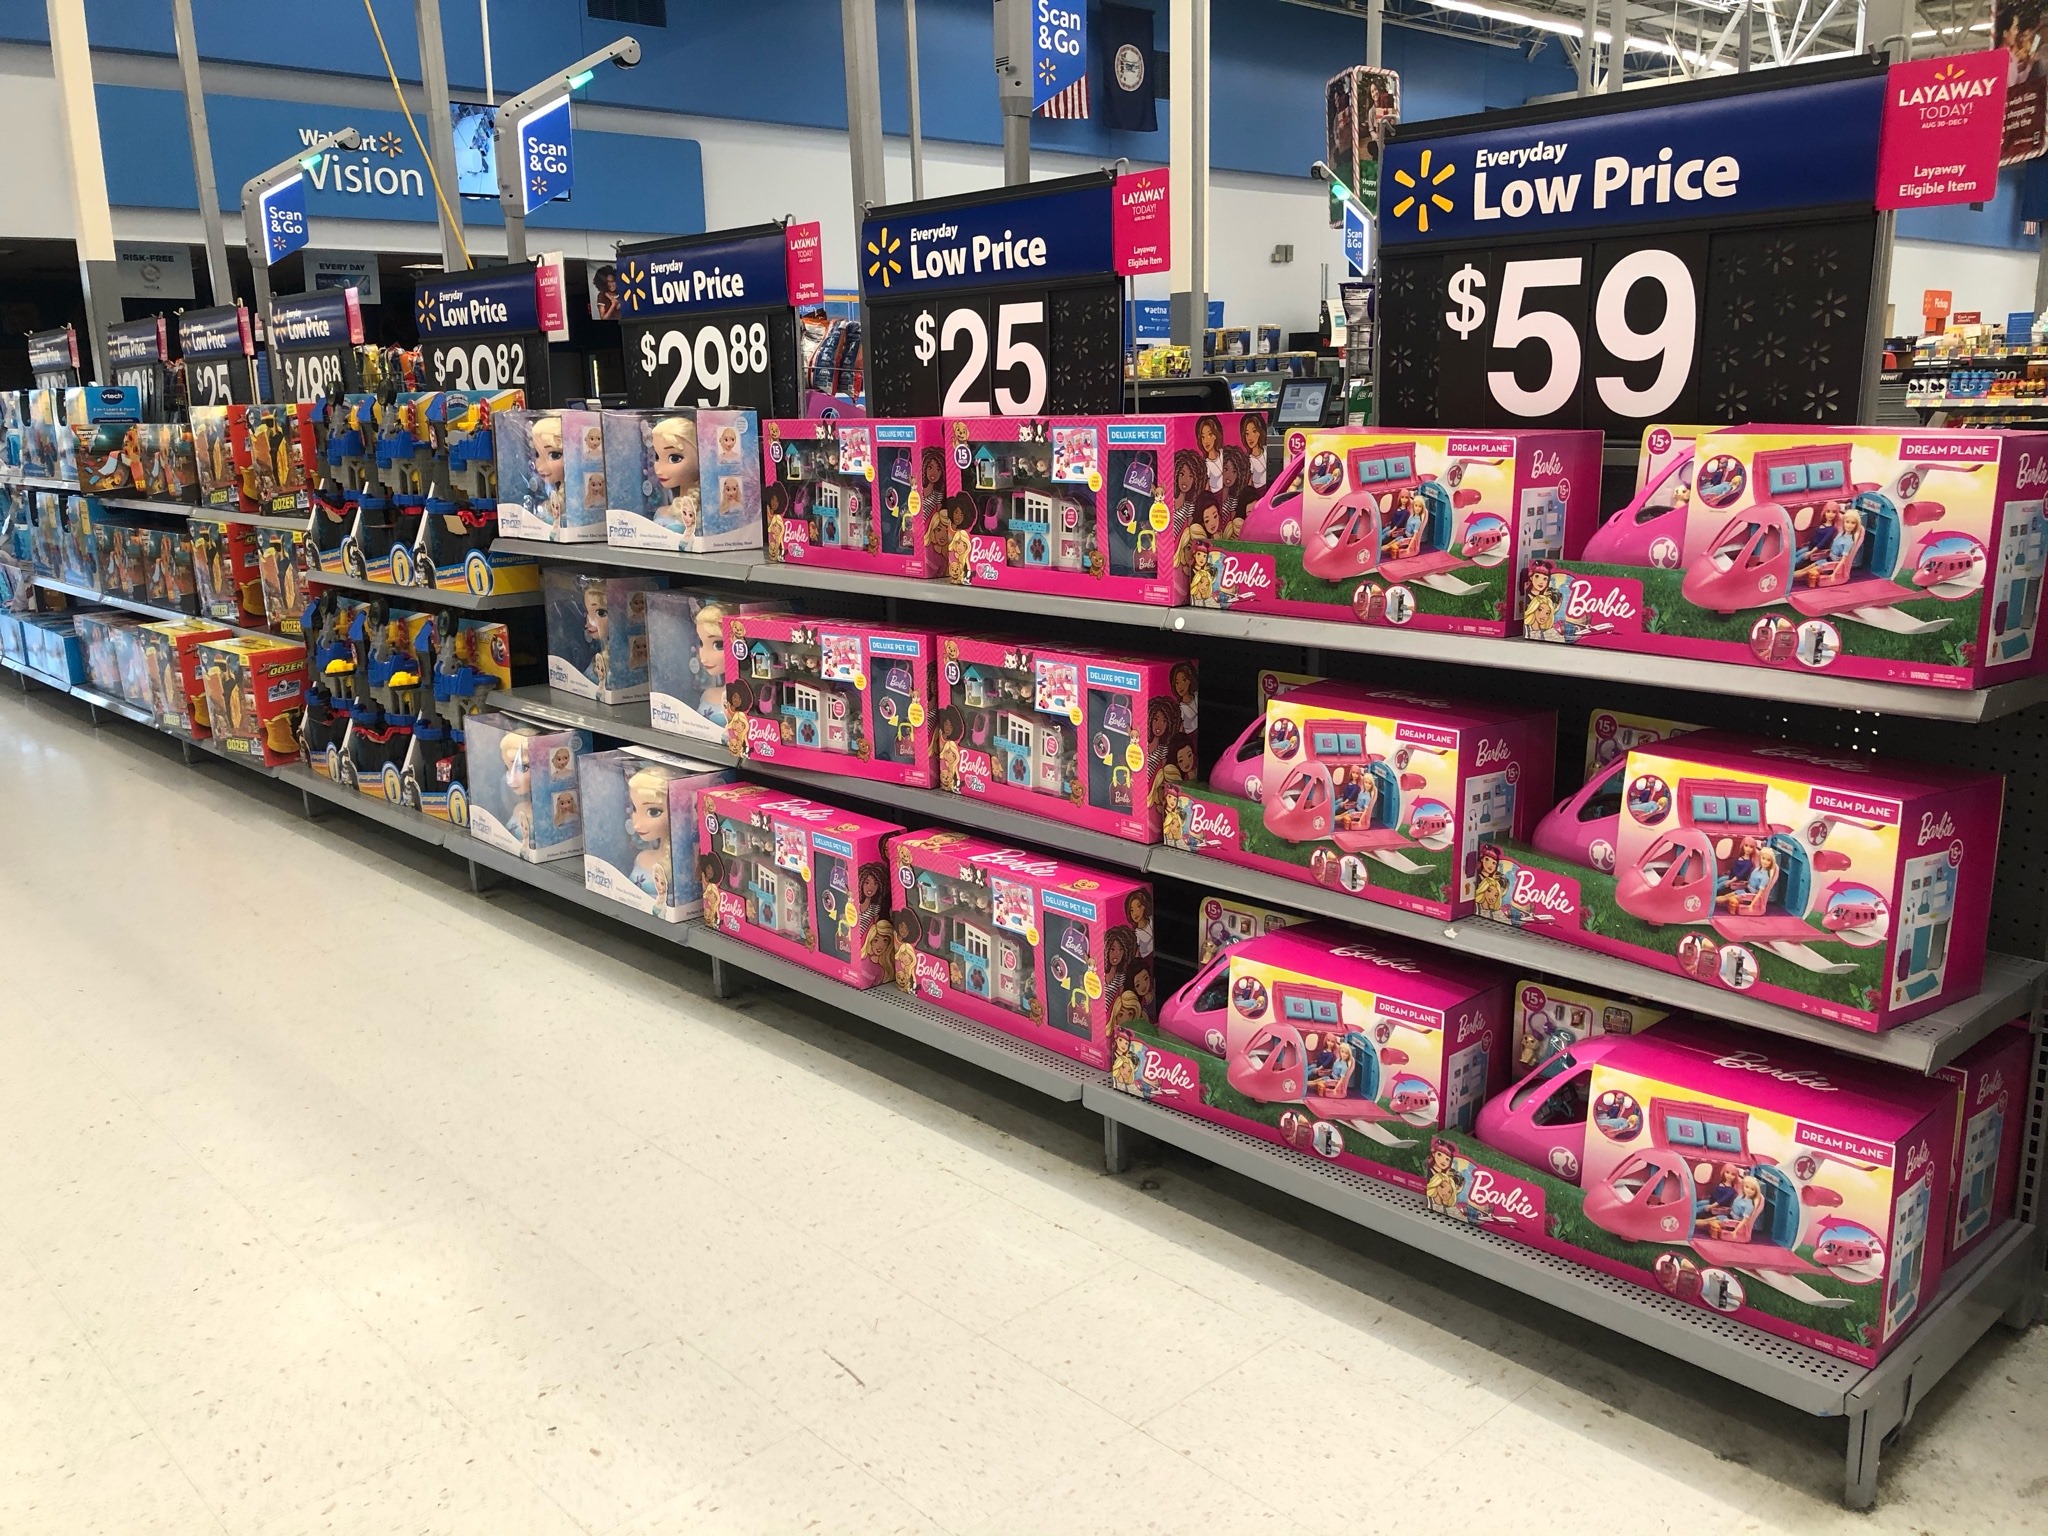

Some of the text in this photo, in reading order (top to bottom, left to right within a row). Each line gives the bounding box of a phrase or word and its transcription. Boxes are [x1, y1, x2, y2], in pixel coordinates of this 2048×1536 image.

[1037, 0, 1081, 31] Scan
[1038, 25, 1080, 56] &Go
[1898, 77, 1997, 107] LAYAWAY
[1919, 102, 1973, 120] TODAY!
[299, 128, 377, 151] Walrt
[527, 137, 567, 157] Scan
[529, 153, 567, 175] &Go
[1476, 142, 1567, 170] Everyday
[307, 153, 424, 196] Vision
[1914, 164, 1966, 179] Layaway
[1473, 148, 1738, 221] Low Price
[1899, 180, 1976, 198] Eligible Item
[1122, 187, 1166, 206] LAYAWAY
[269, 206, 302, 221] Scan
[1132, 204, 1157, 216] TODAY!
[271, 219, 303, 234] &Go
[910, 223, 958, 245] Everyday
[1347, 229, 1362, 240] Scan
[790, 237, 818, 250] LAYAWAY
[1133, 246, 1157, 255] Layaway
[1347, 238, 1362, 249] &Go
[122, 253, 175, 263] RISK-FREE
[910, 229, 1047, 281] Low Price
[1128, 256, 1162, 269] Eligible Item
[319, 263, 365, 272] EVERY DAY
[651, 260, 683, 274] Everyday
[651, 267, 744, 305] Low Price
[439, 290, 463, 302] Everyday
[440, 298, 507, 327] Low Price
[287, 315, 330, 340] Low Price
[1445, 250, 1696, 418] $59
[191, 330, 227, 351] Low Price
[914, 302, 1047, 417] $25
[1111, 430, 1163, 440] DELUXE PET SET
[1290, 436, 1305, 451] 15+
[1652, 435, 1670, 448] 15+
[773, 446, 780, 455] 15
[957, 448, 967, 459] 15
[1451, 443, 1508, 453] DREAM PLANE
[1906, 445, 1990, 456] DREAM PLANE
[894, 465, 908, 480] Barbie
[1531, 450, 1563, 479] Barbie
[1129, 470, 1147, 489] Barbie
[609, 526, 637, 538] FROZEN
[784, 521, 809, 543] Barbie
[970, 536, 1005, 564] Barbie
[1221, 555, 1271, 590] Barbie
[1568, 580, 1636, 619] Barbie
[735, 643, 744, 653] 15
[872, 642, 916, 653] DELUXE PET SET
[948, 665, 957, 676] 15
[1090, 672, 1137, 686] DELUXE PET SET
[891, 675, 907, 690] Barbie
[1263, 677, 1279, 693] 15+
[652, 709, 680, 725] FROZEN
[1108, 713, 1128, 729] Barbie
[1598, 718, 1615, 733] 15+
[748, 719, 779, 743] Barbie
[1399, 728, 1453, 745] DREAM PLANE
[1475, 738, 1511, 767] Barbie
[959, 750, 990, 777] Barbie
[758, 798, 835, 821] Barbie
[1815, 795, 1892, 818] DREAM PLANE
[707, 816, 716, 827] 15
[1191, 804, 1236, 840] Barbie
[1917, 811, 1956, 847] Barbie
[967, 849, 1059, 878] Barbie
[586, 871, 613, 890] FROZEN
[832, 874, 846, 888] Barbie
[901, 871, 911, 881] 15
[1514, 870, 1575, 914] Barbie
[719, 893, 745, 917] Barbie
[1045, 896, 1093, 916] DELUXE PET SET
[1206, 903, 1222, 915] 15+
[1065, 937, 1084, 956] Barbie
[1328, 943, 1421, 973] Barbie
[915, 953, 948, 983] Barbie
[1525, 991, 1545, 1004] 15+
[1379, 1002, 1436, 1024] DREAM PLANE
[1456, 1010, 1486, 1043] Barbie
[1144, 1051, 1195, 1090] Barbie
[1712, 1051, 1838, 1092] Barbie
[1801, 1130, 1885, 1160] DREAM PLANE
[1467, 1169, 1539, 1221] Barbie
